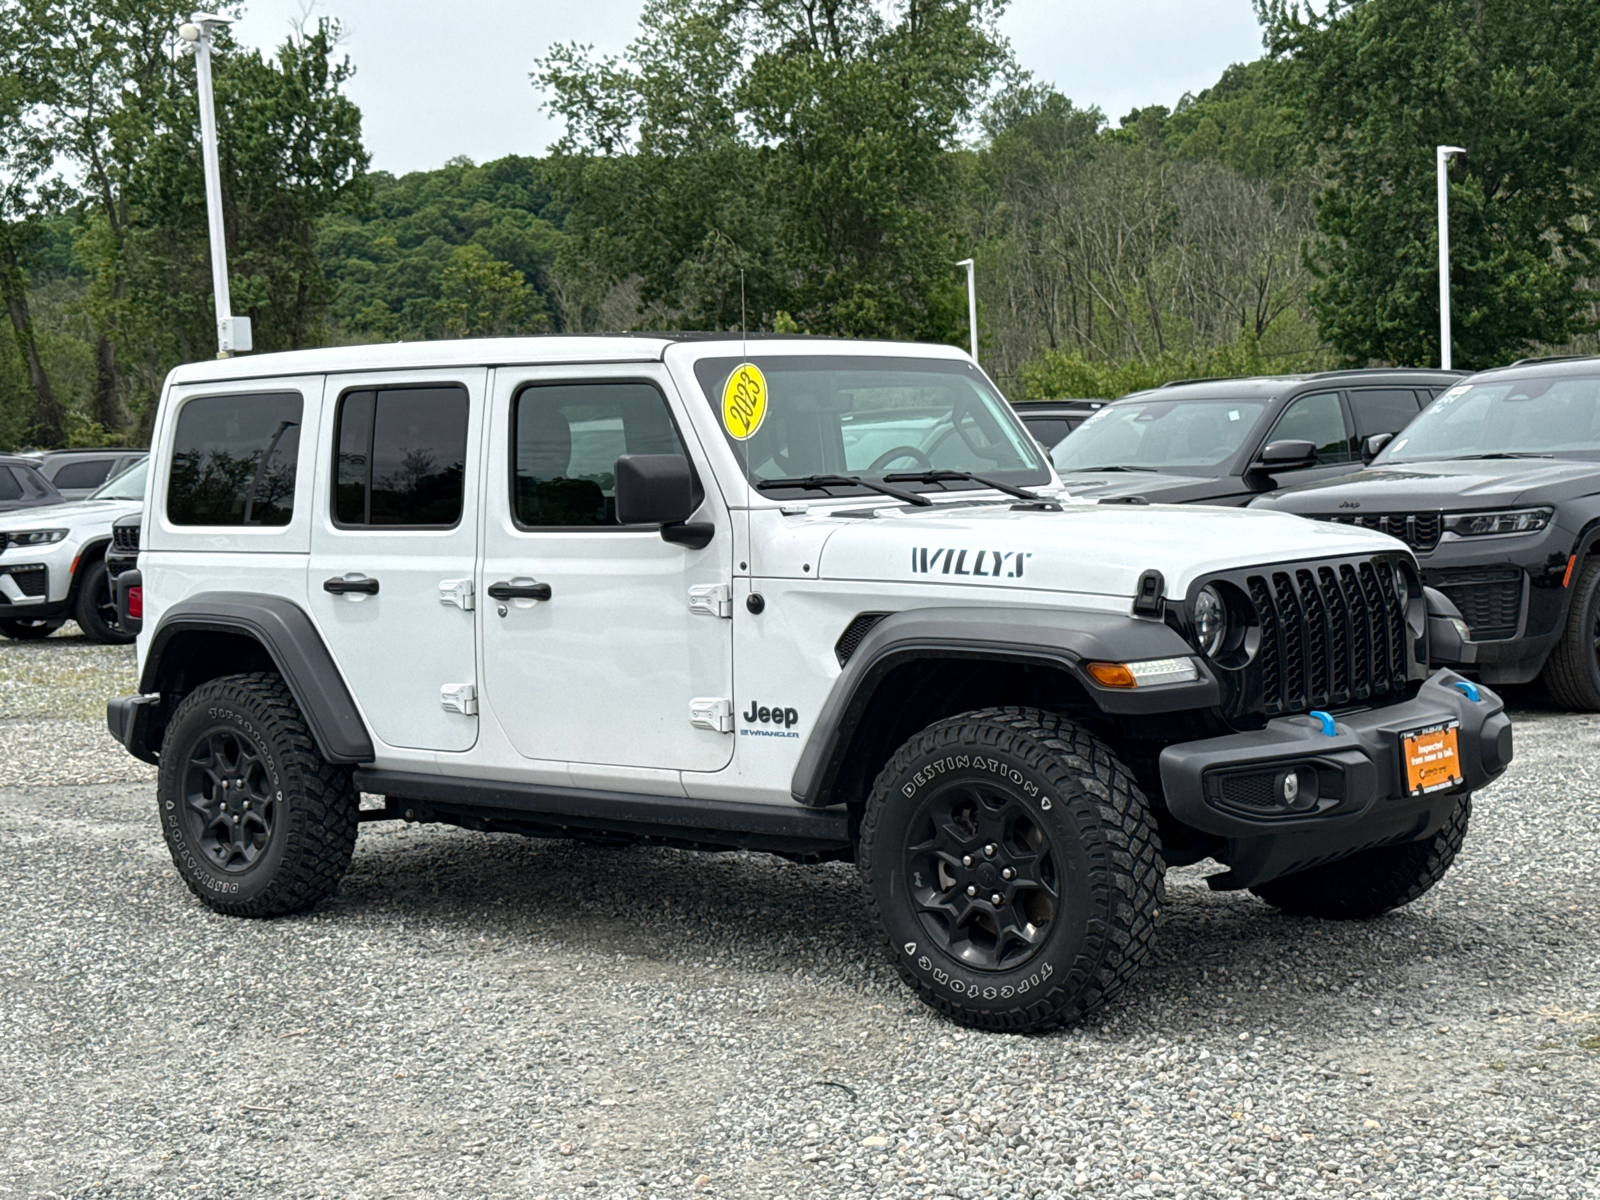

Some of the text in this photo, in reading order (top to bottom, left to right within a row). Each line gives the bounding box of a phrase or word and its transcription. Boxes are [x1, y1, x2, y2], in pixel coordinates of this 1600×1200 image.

[730, 371, 760, 431] 2023
[912, 547, 1033, 578] WILLYS
[743, 701, 798, 729] Jeep
[748, 730, 799, 738] WRANGLER
[1417, 740, 1443, 754] Inspected
[1411, 757, 1423, 766] from
[1437, 751, 1443, 759] to
[902, 754, 1038, 799] DESTINATION
[170, 815, 239, 894] DESTINATION
